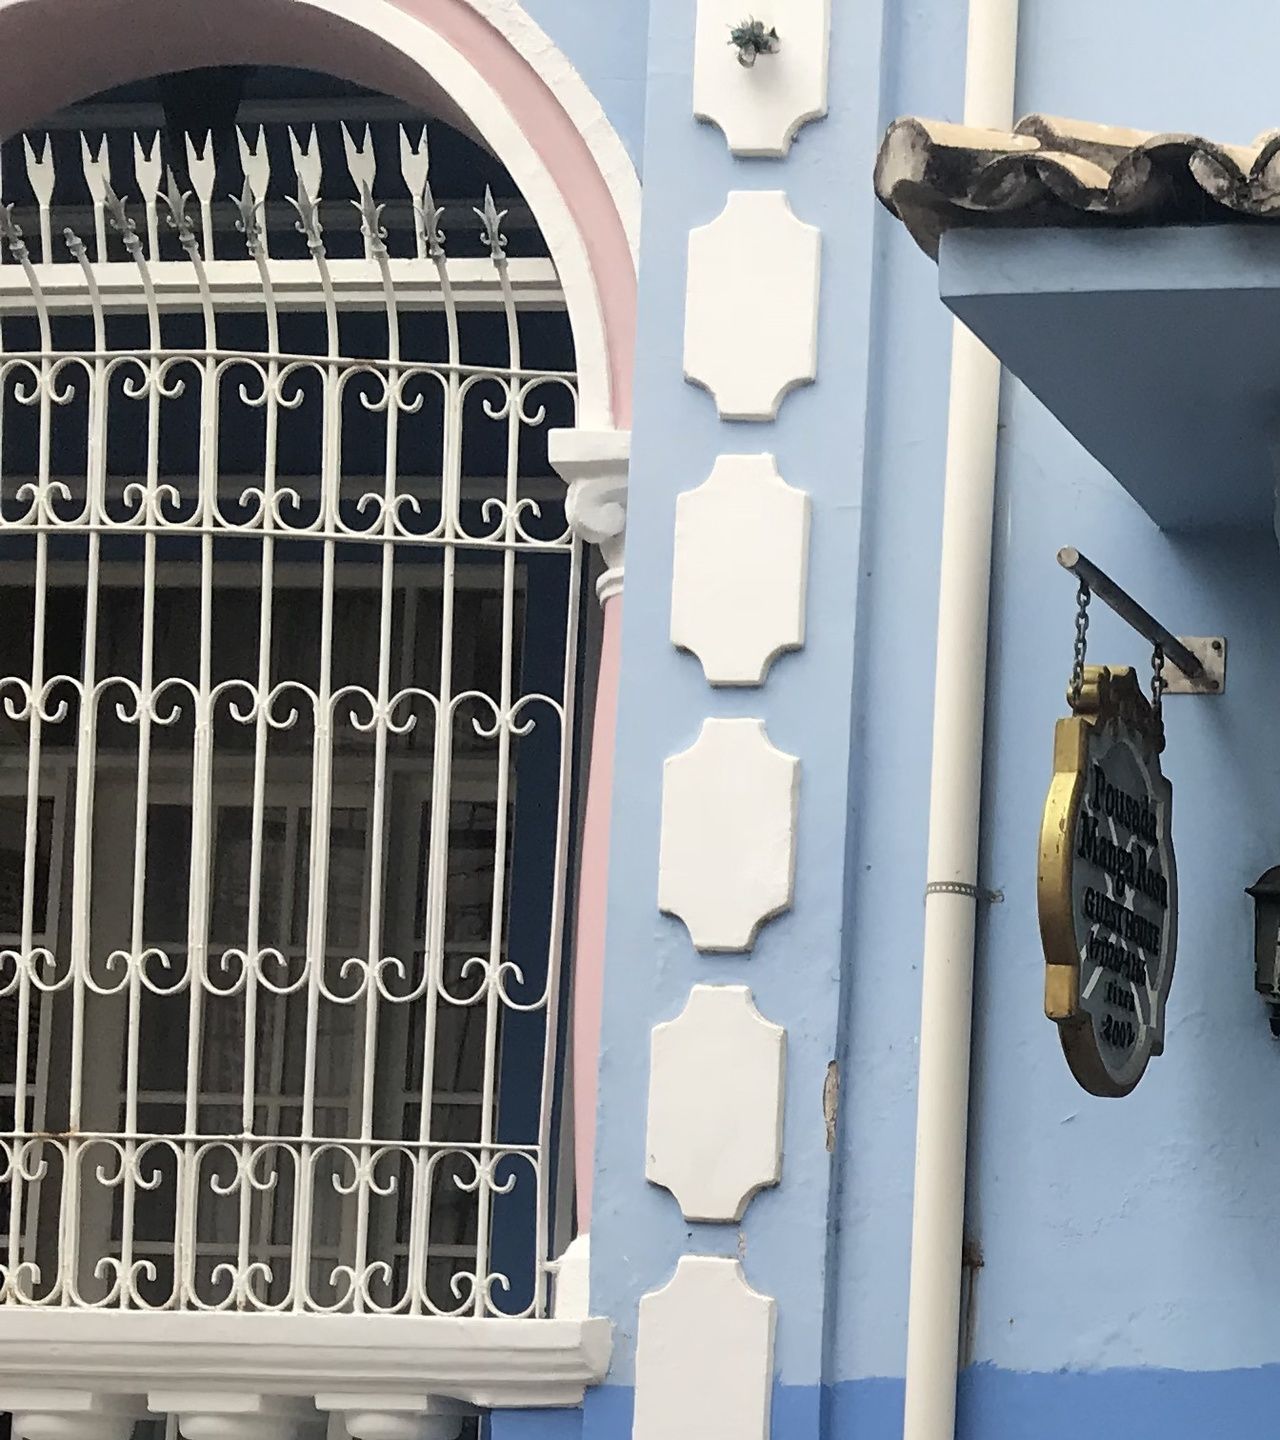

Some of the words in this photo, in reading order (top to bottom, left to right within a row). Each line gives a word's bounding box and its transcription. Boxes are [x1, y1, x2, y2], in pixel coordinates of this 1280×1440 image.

[1092, 763, 1159, 848] Pousada
[1077, 810, 1134, 898] Manga
[1134, 843, 1168, 909] Rosa
[1085, 886, 1124, 938] GUEST
[1125, 909, 1161, 957] HOUSE
[1100, 1013, 1137, 1049] 2002
